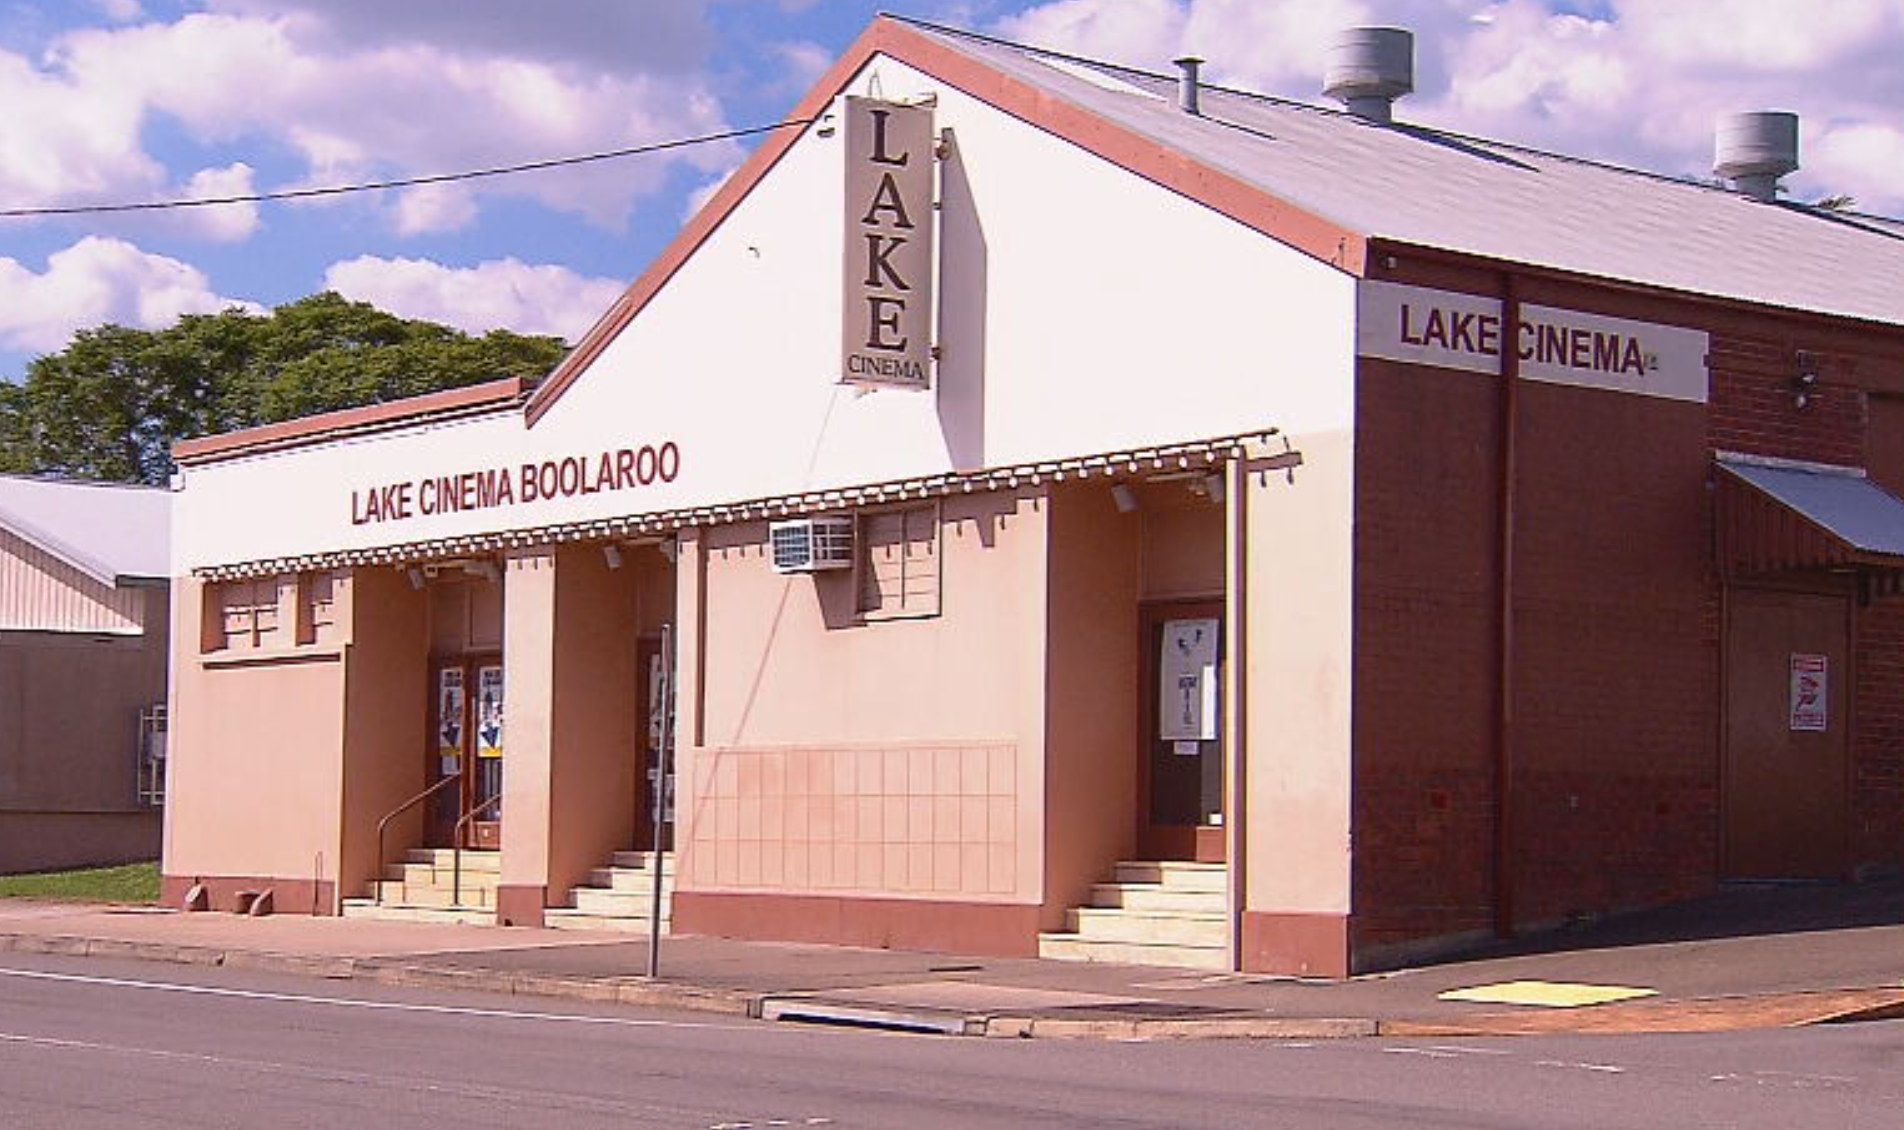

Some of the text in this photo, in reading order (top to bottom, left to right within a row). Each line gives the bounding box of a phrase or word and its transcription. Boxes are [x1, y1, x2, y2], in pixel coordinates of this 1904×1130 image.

[861, 109, 915, 353] LAKE
[847, 353, 925, 381] CINEMA
[1400, 303, 1645, 377] LAKE CINEMA
[352, 441, 681, 525] LAKE CINEMA BOOLAROO
